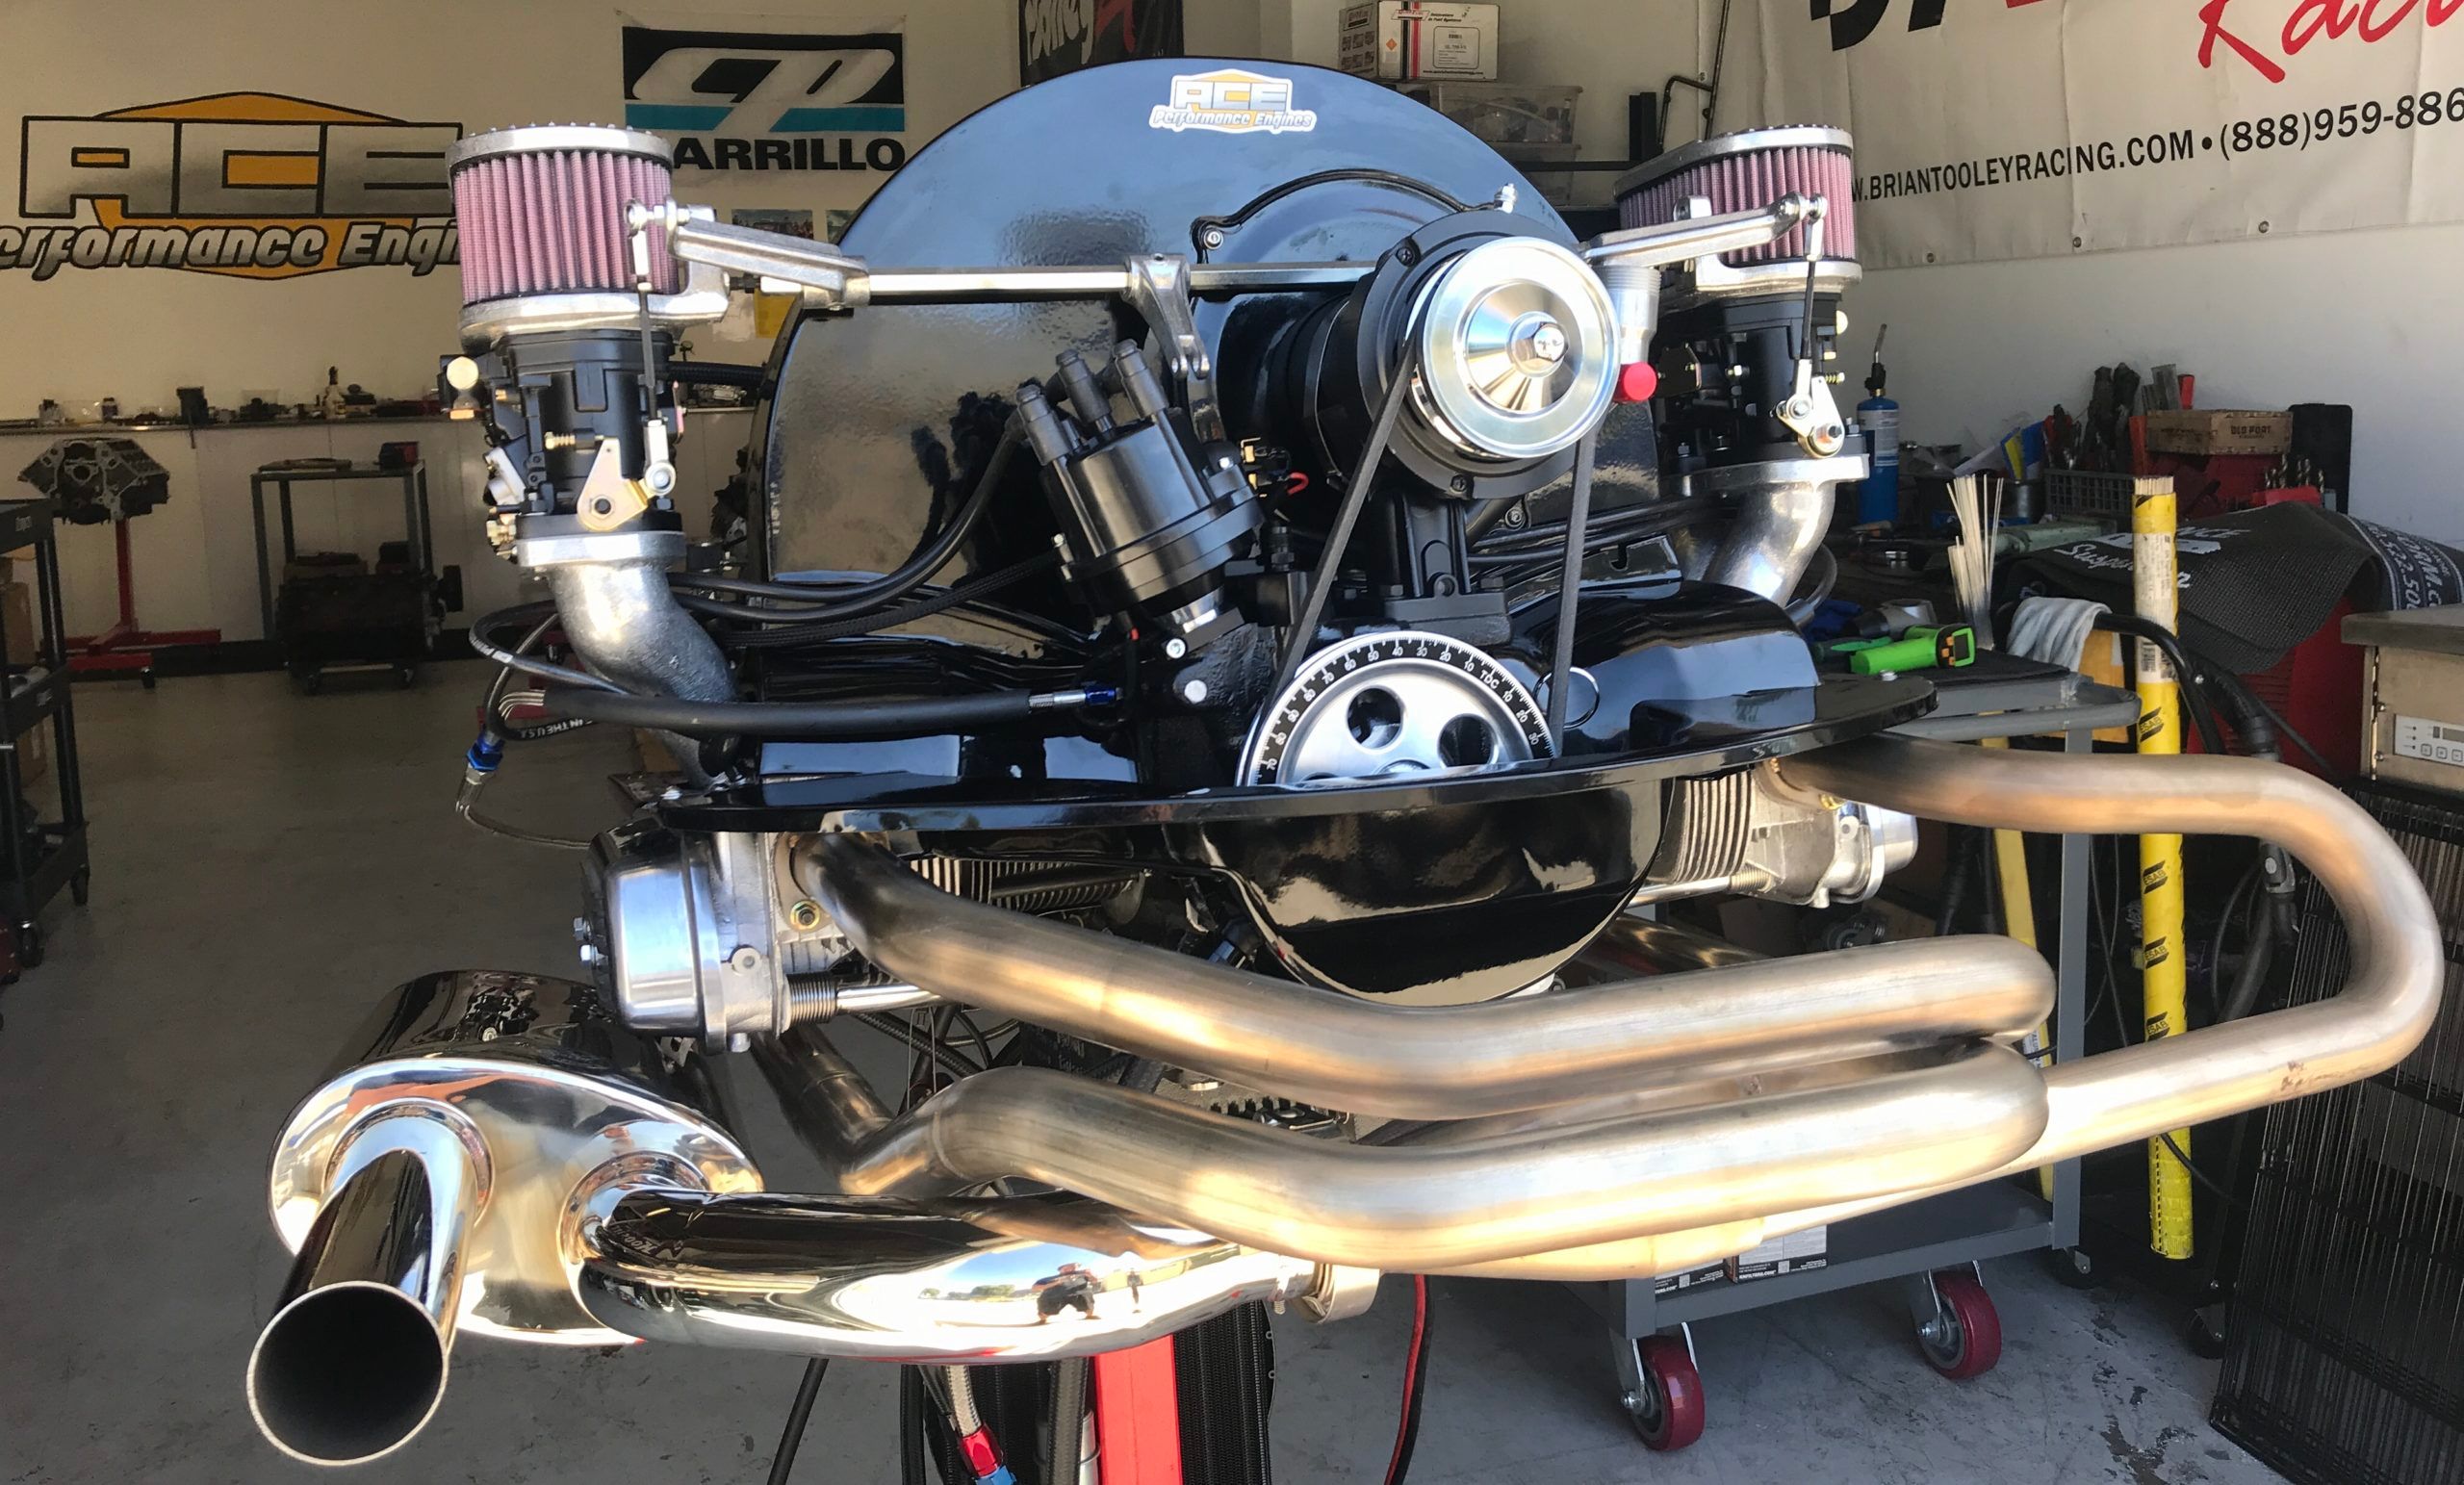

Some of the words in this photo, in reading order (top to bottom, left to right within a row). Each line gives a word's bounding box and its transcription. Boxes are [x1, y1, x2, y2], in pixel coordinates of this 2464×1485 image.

[1173, 79, 1289, 112] ACE
[1154, 109, 1251, 129] Performance
[1253, 112, 1314, 130] Engines
[19, 115, 464, 219] ACE
[674, 137, 906, 171] ARRILLO
[1266, 757, 1278, 771] 70
[1274, 731, 1287, 746] 80
[1287, 708, 1300, 723] 90
[1303, 688, 1317, 703] 80
[1322, 672, 1335, 685] 70
[1344, 658, 1357, 672] 60
[1367, 650, 1380, 662] 50
[1391, 646, 1404, 657] 40
[1416, 647, 1428, 657] 30
[1439, 651, 1452, 663] 20
[1463, 660, 1476, 673] 10
[1478, 669, 1501, 689] TDC
[1502, 690, 1513, 703] 10
[1516, 710, 1528, 724] 20
[1527, 732, 1540, 746] 30
[2143, 869, 2167, 886] ESAB
[2144, 945, 2167, 961] ESAB
[2146, 1019, 2169, 1036] ESAB
